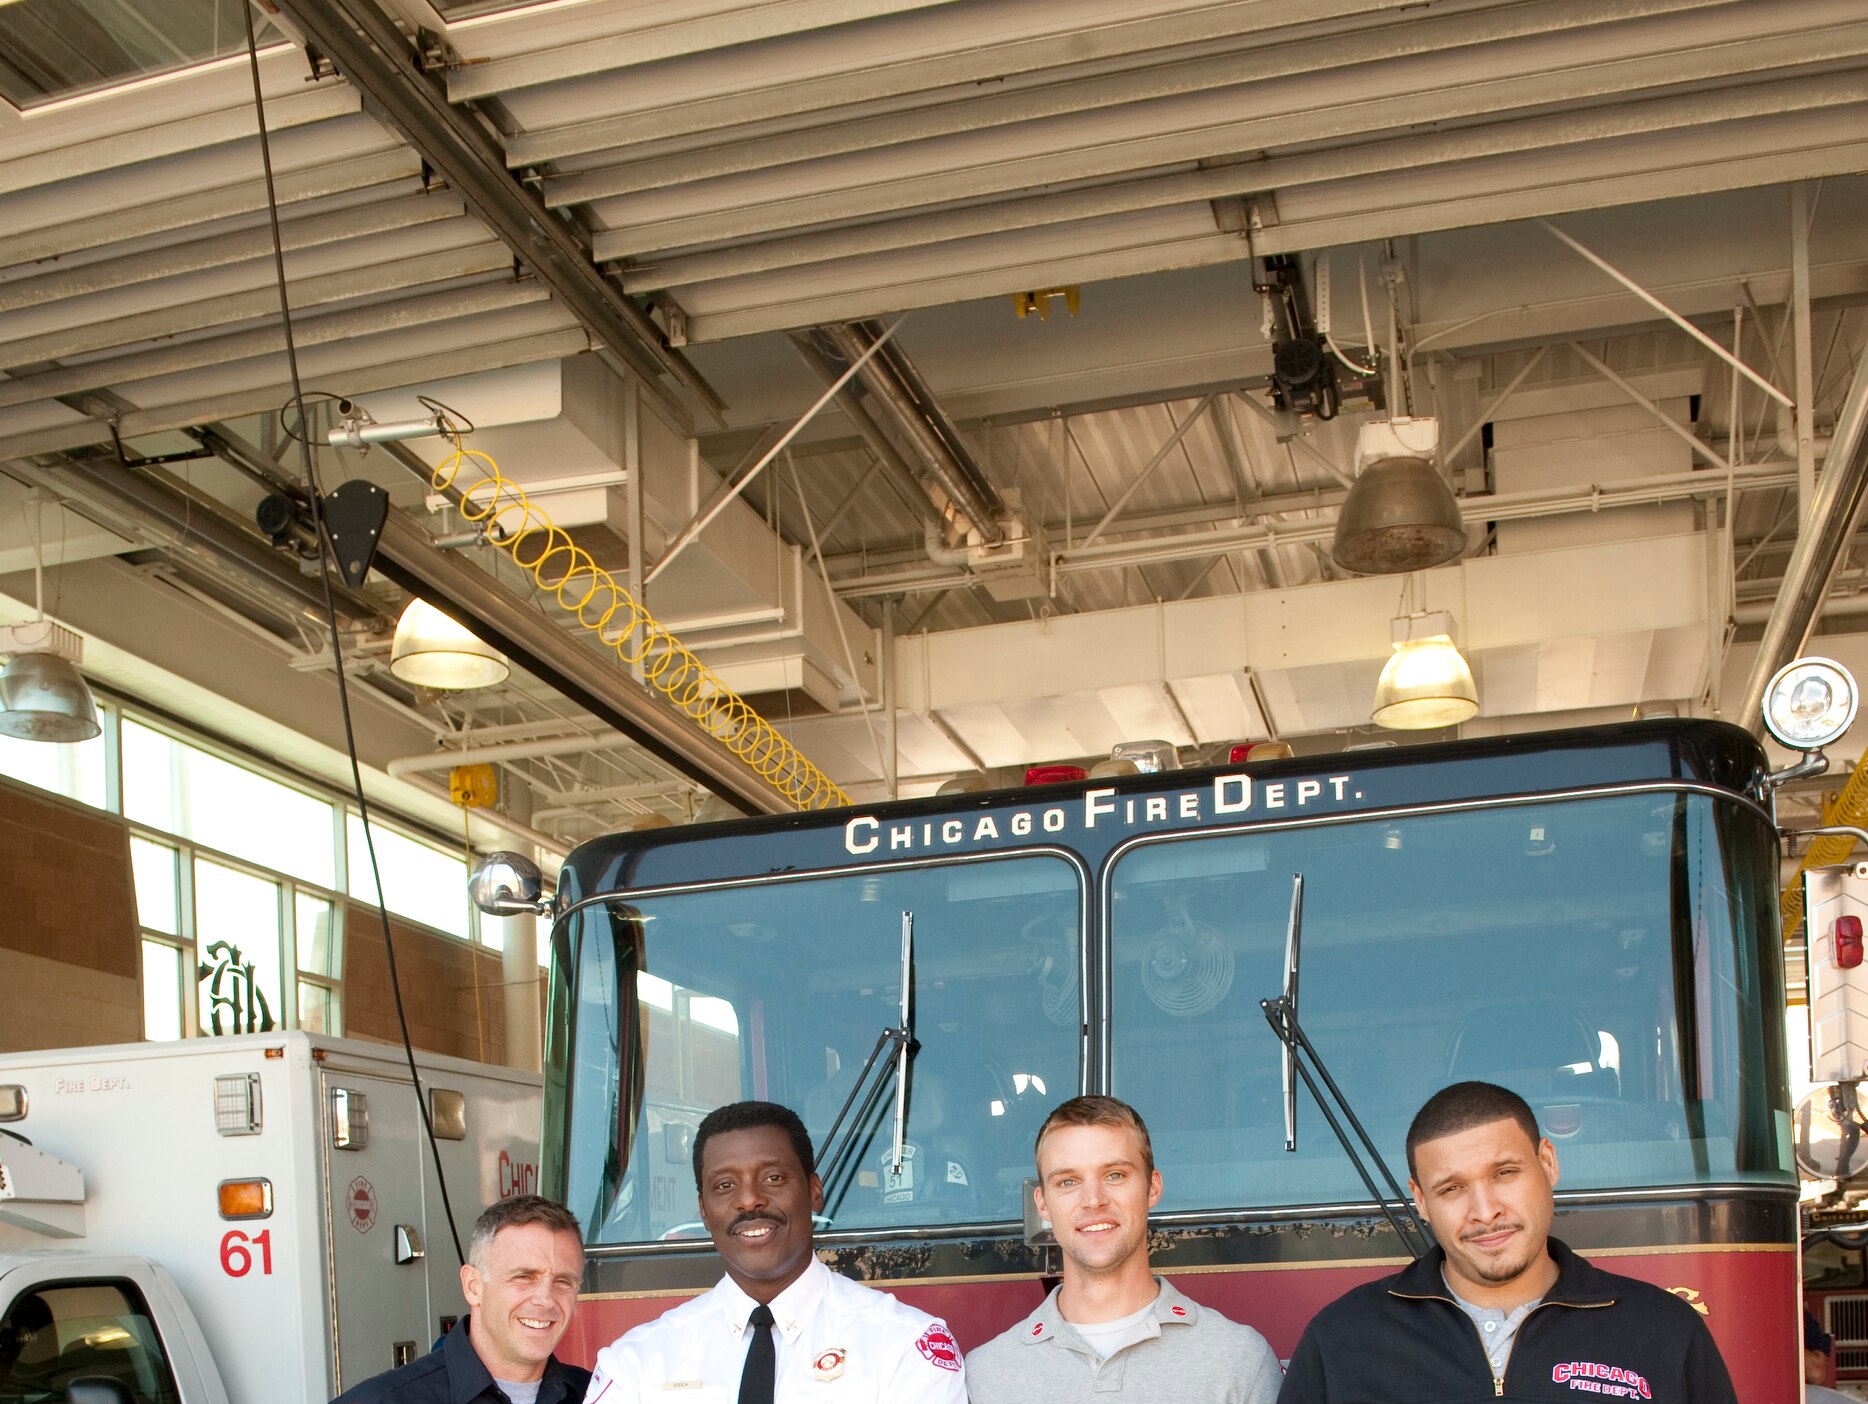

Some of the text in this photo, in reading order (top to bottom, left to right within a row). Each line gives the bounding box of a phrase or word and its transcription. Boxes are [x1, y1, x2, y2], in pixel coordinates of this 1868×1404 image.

[845, 774, 1363, 855] CHICAGO FIRE DEPT.
[56, 1076, 130, 1094] FIRE DEPT.
[220, 1230, 272, 1277] 61
[1552, 1362, 1652, 1399] CHICAGO
[1570, 1379, 1640, 1400] FIRE DEPT.
